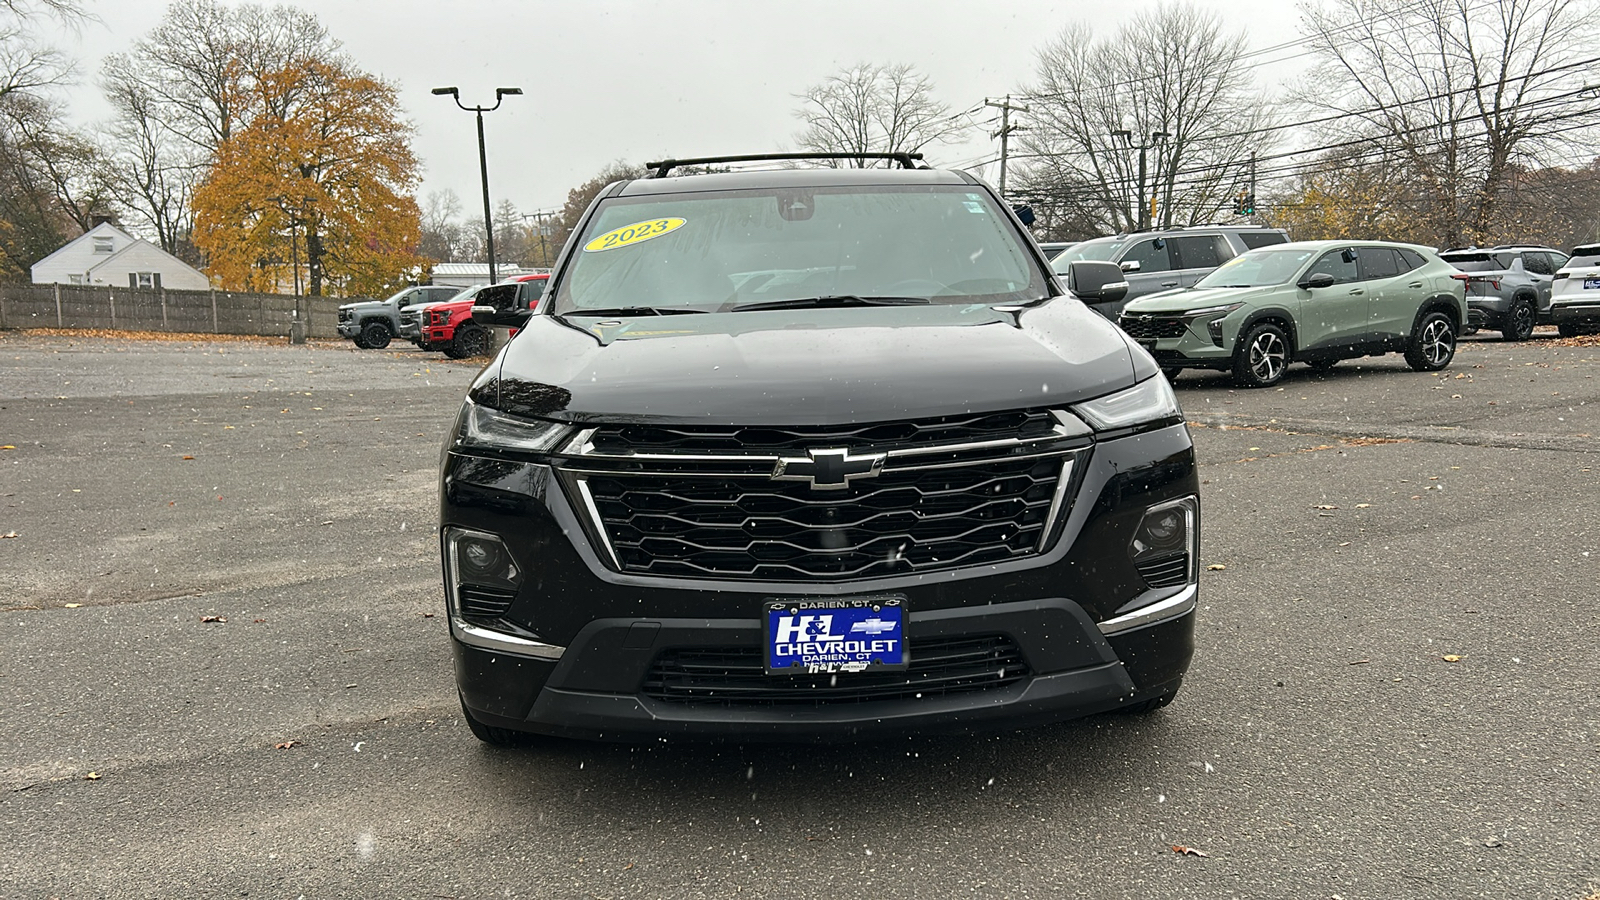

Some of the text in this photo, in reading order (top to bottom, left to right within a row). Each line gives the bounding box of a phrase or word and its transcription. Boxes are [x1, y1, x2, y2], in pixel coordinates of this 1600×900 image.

[603, 220, 669, 248] 2023
[775, 615, 845, 643] H&L
[776, 640, 897, 656] CHEVROLET
